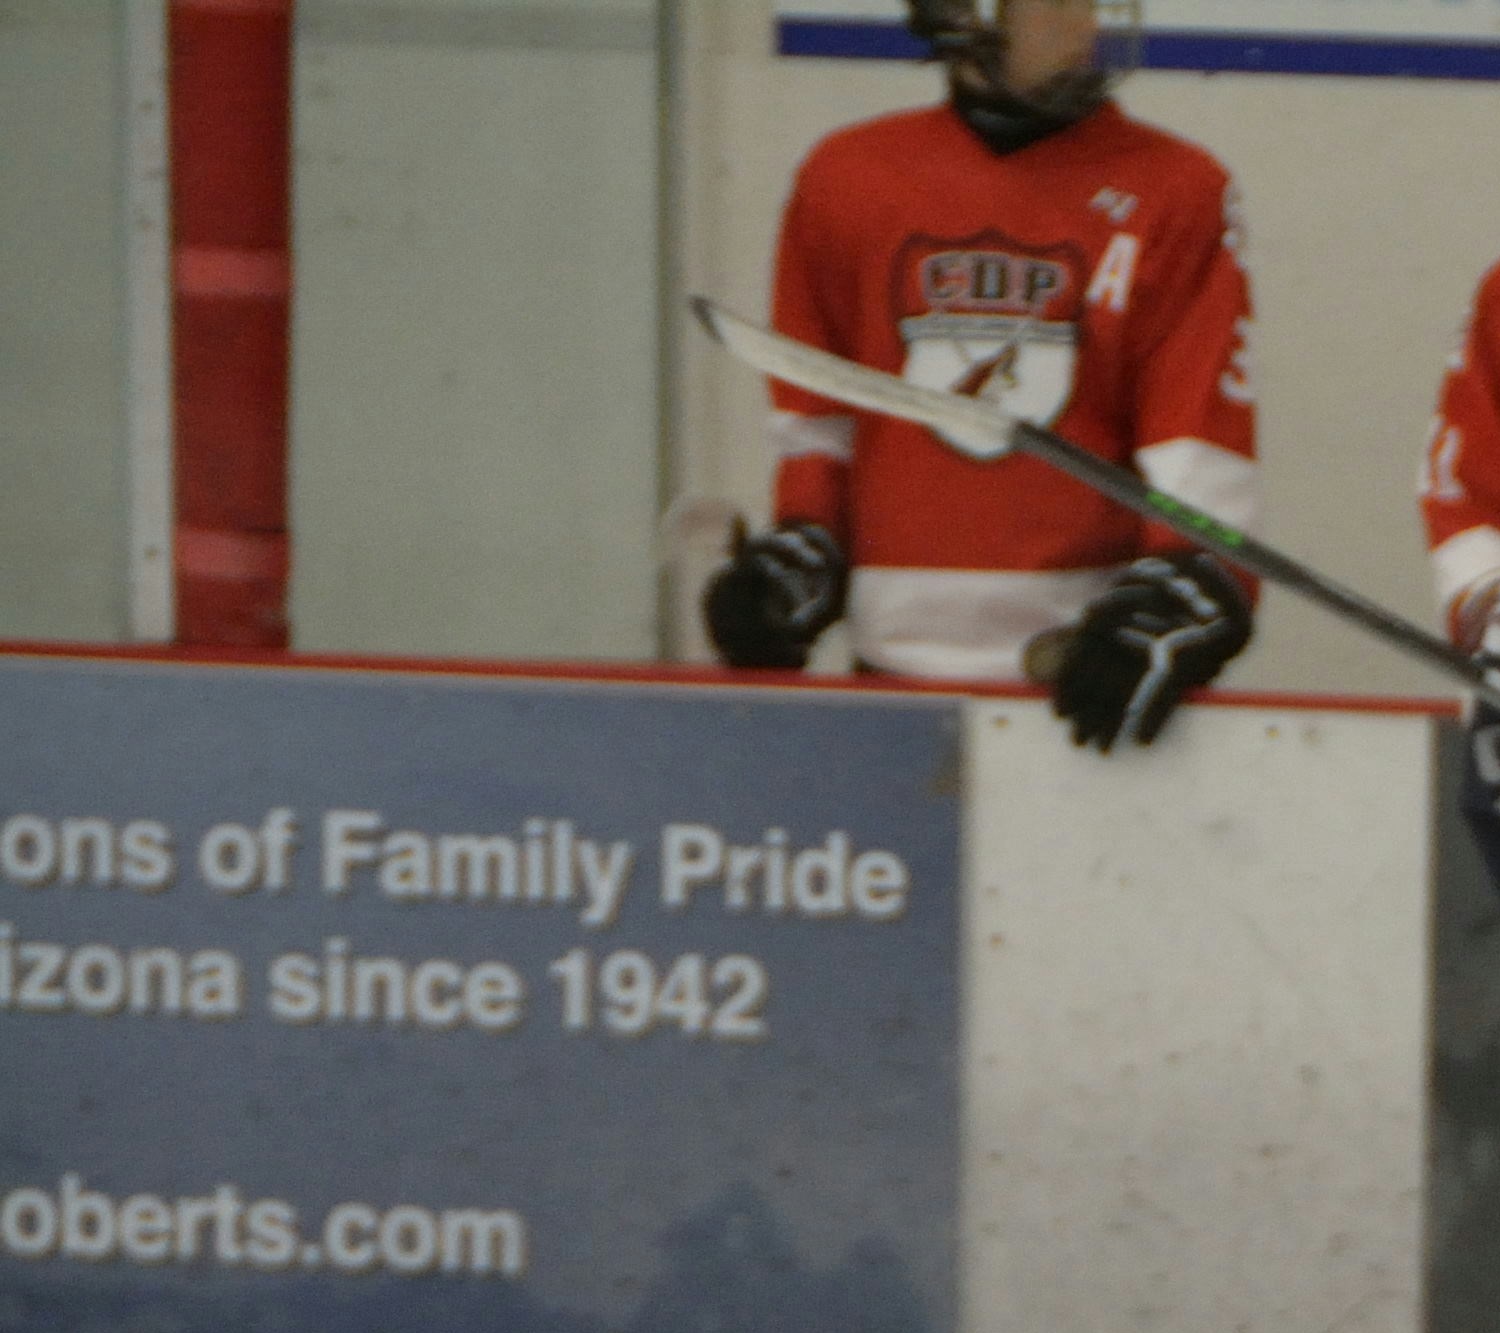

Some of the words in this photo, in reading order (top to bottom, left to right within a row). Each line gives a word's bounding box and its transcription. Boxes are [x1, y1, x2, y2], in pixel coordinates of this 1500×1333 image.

[1085, 232, 1138, 313] A
[200, 809, 297, 892] of
[321, 810, 632, 924] Family
[660, 822, 910, 917] Pride
[269, 935, 525, 1031] since
[549, 948, 772, 1040] 1942
